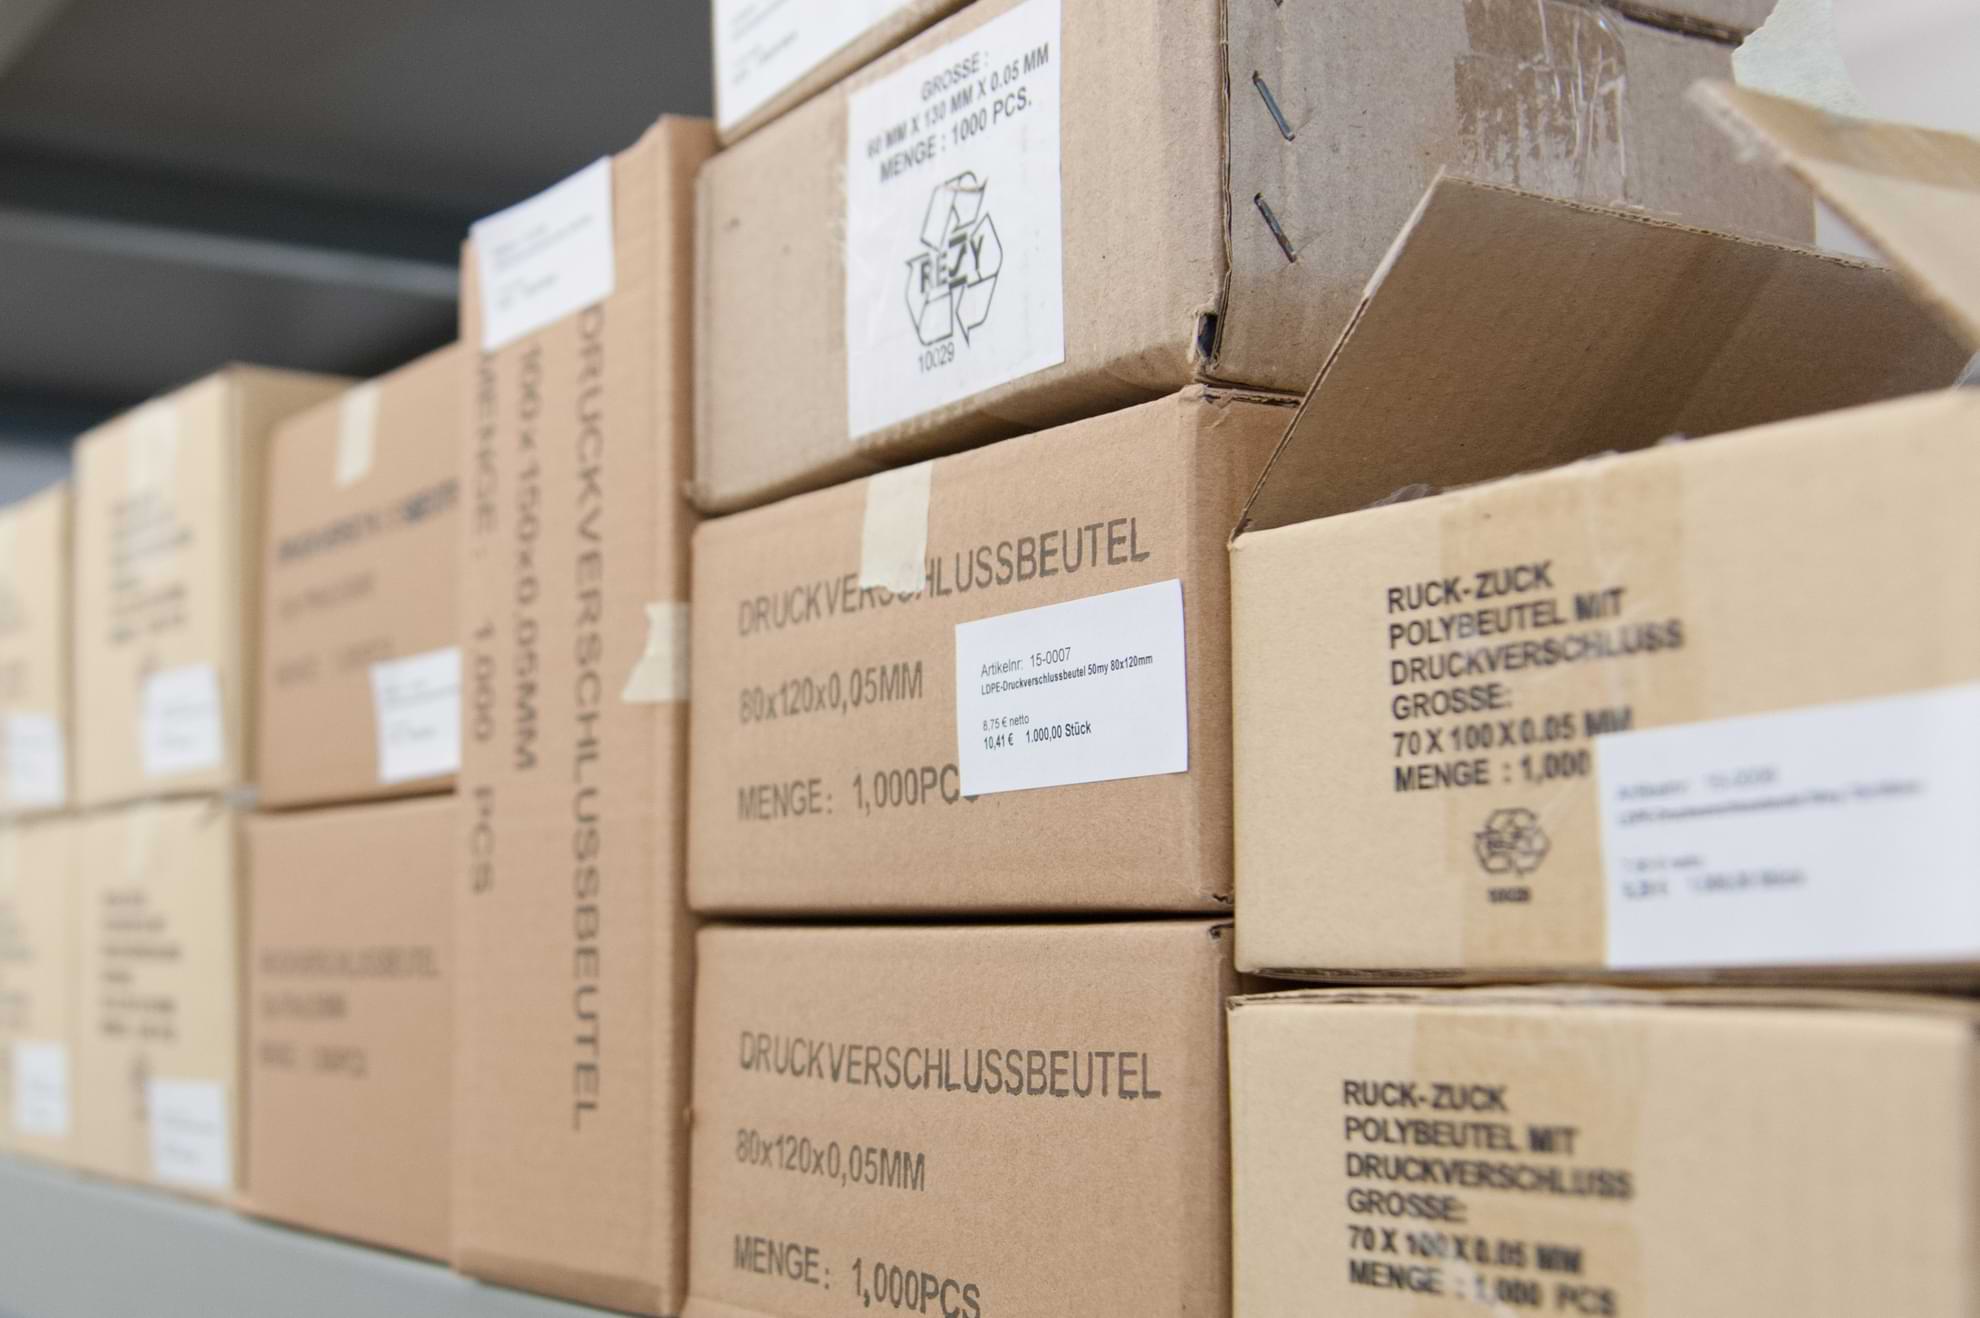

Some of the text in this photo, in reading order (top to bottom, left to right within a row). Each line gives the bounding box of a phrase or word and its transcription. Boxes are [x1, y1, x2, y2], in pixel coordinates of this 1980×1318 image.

[886, 121, 907, 148] MM
[911, 113, 920, 135] X
[925, 100, 946, 128] 130
[950, 84, 973, 114] MM
[977, 77, 987, 101] X
[990, 60, 1020, 92] 0.05
[1023, 42, 1050, 75] MM
[921, 51, 980, 101] GROSSE
[880, 134, 936, 183] MENGE
[951, 107, 988, 144] 1000
[993, 86, 1032, 125] PCS.
[738, 517, 1151, 636] DRUCKVERHLUSSBEUTEL
[1388, 560, 1554, 614] RUCK-ZUCK
[1389, 586, 1626, 650] POLYBEUTEL MIT
[981, 646, 1072, 678] Artikelnr: 15-0007
[981, 654, 1154, 696] LDPE-Druckverschlussbeutel 50my 80x120mm
[1391, 618, 1685, 687] DRUCKVERSCHLUSS
[574, 303, 604, 1131] DRUCKVERSCHLUSSBEUTEL
[982, 714, 1030, 731] 8,75 € netto
[1392, 683, 1513, 721] GROSSE:
[983, 720, 1092, 751] 10,41 € 1.000,00 Stück
[1392, 731, 1421, 758] 70
[1426, 728, 1444, 754] X
[1450, 723, 1494, 752] 100
[1499, 720, 1516, 747] X
[1519, 712, 1576, 745] 0.05
[737, 763, 980, 821] MENGE: 1,000PC
[1394, 758, 1490, 793] MENGE
[1520, 749, 1591, 786] 1,000
[469, 785, 495, 896] PCS
[739, 1030, 1162, 1100] DRUCKVERSCHLUSSBEUTEL
[1343, 1080, 1508, 1112] RUCK-ZUCK
[735, 1128, 926, 1193] 80x120x0,05MM
[1344, 1116, 1579, 1156] POLYBEUTEL MIT
[1345, 1152, 1635, 1202] DRUCKVERSCHLUSS
[733, 1234, 981, 1318] MENGE: 1,000PCS
[1348, 1225, 1376, 1252] 70
[1381, 1228, 1398, 1254] X
[1453, 1236, 1470, 1263] X
[1474, 1237, 1527, 1268] 0.05
[1536, 1244, 1583, 1274] MM
[1348, 1258, 1444, 1295] MENGE
[1555, 1283, 1619, 1317] PCS
